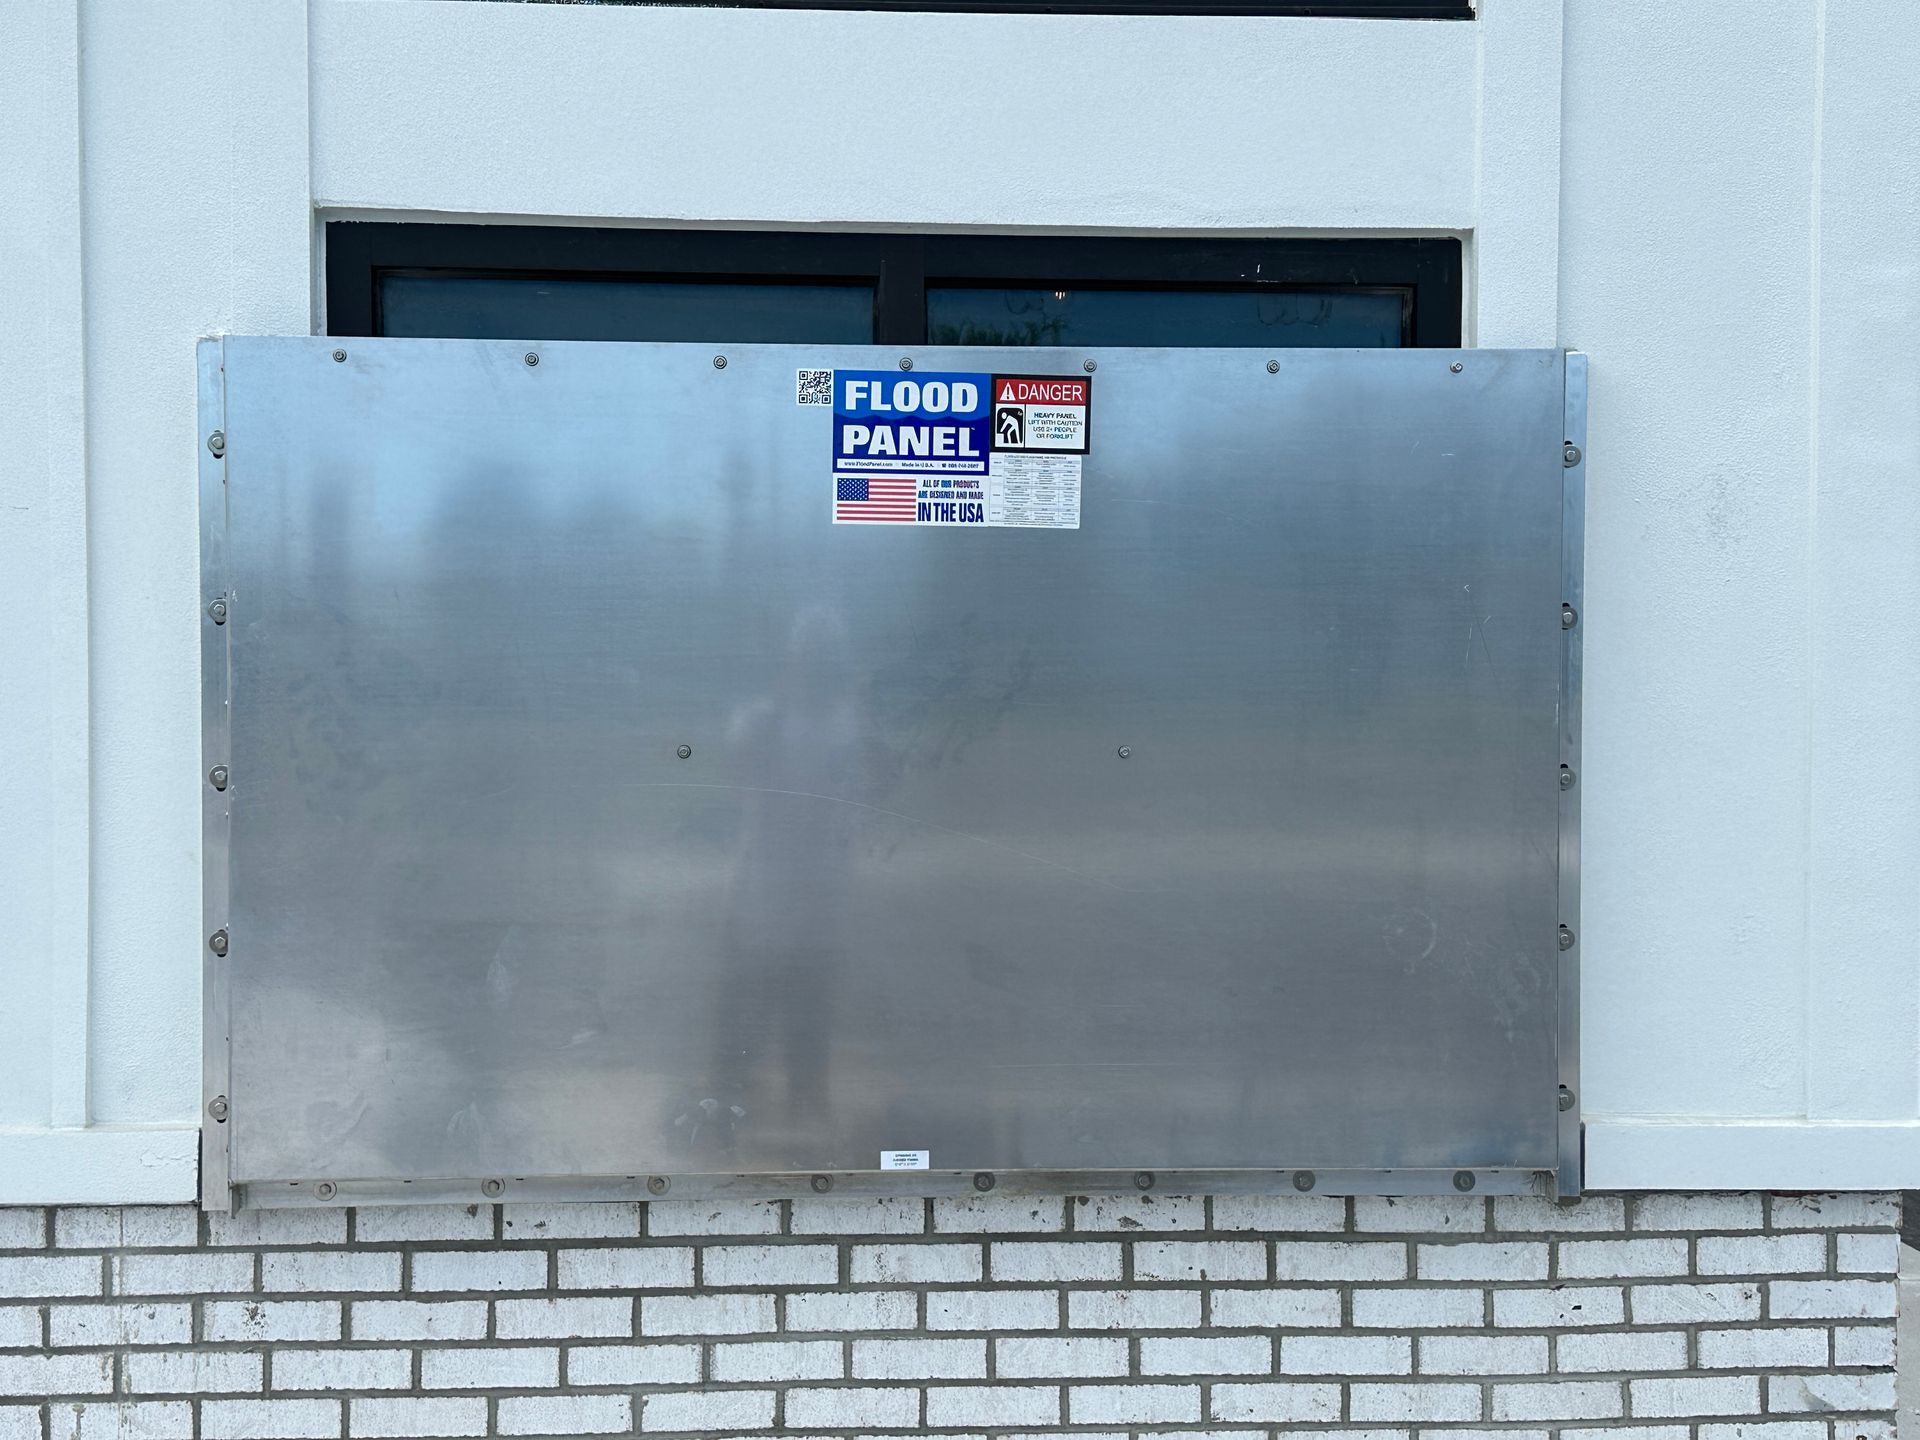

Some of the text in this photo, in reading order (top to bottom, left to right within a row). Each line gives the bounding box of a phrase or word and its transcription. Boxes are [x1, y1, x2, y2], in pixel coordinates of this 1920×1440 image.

[845, 380, 979, 413] FLOOD
[1018, 383, 1083, 402] DANGER
[842, 424, 979, 457] PANEL
[922, 479, 980, 489] ALL OF OUR PRODUCTS
[918, 490, 928, 499] ARE
[929, 490, 955, 499] DESIGNED
[956, 491, 968, 500] AND
[968, 491, 984, 500] MADE
[917, 502, 931, 522] IN
[932, 502, 957, 522] THE
[958, 502, 985, 523] USA
